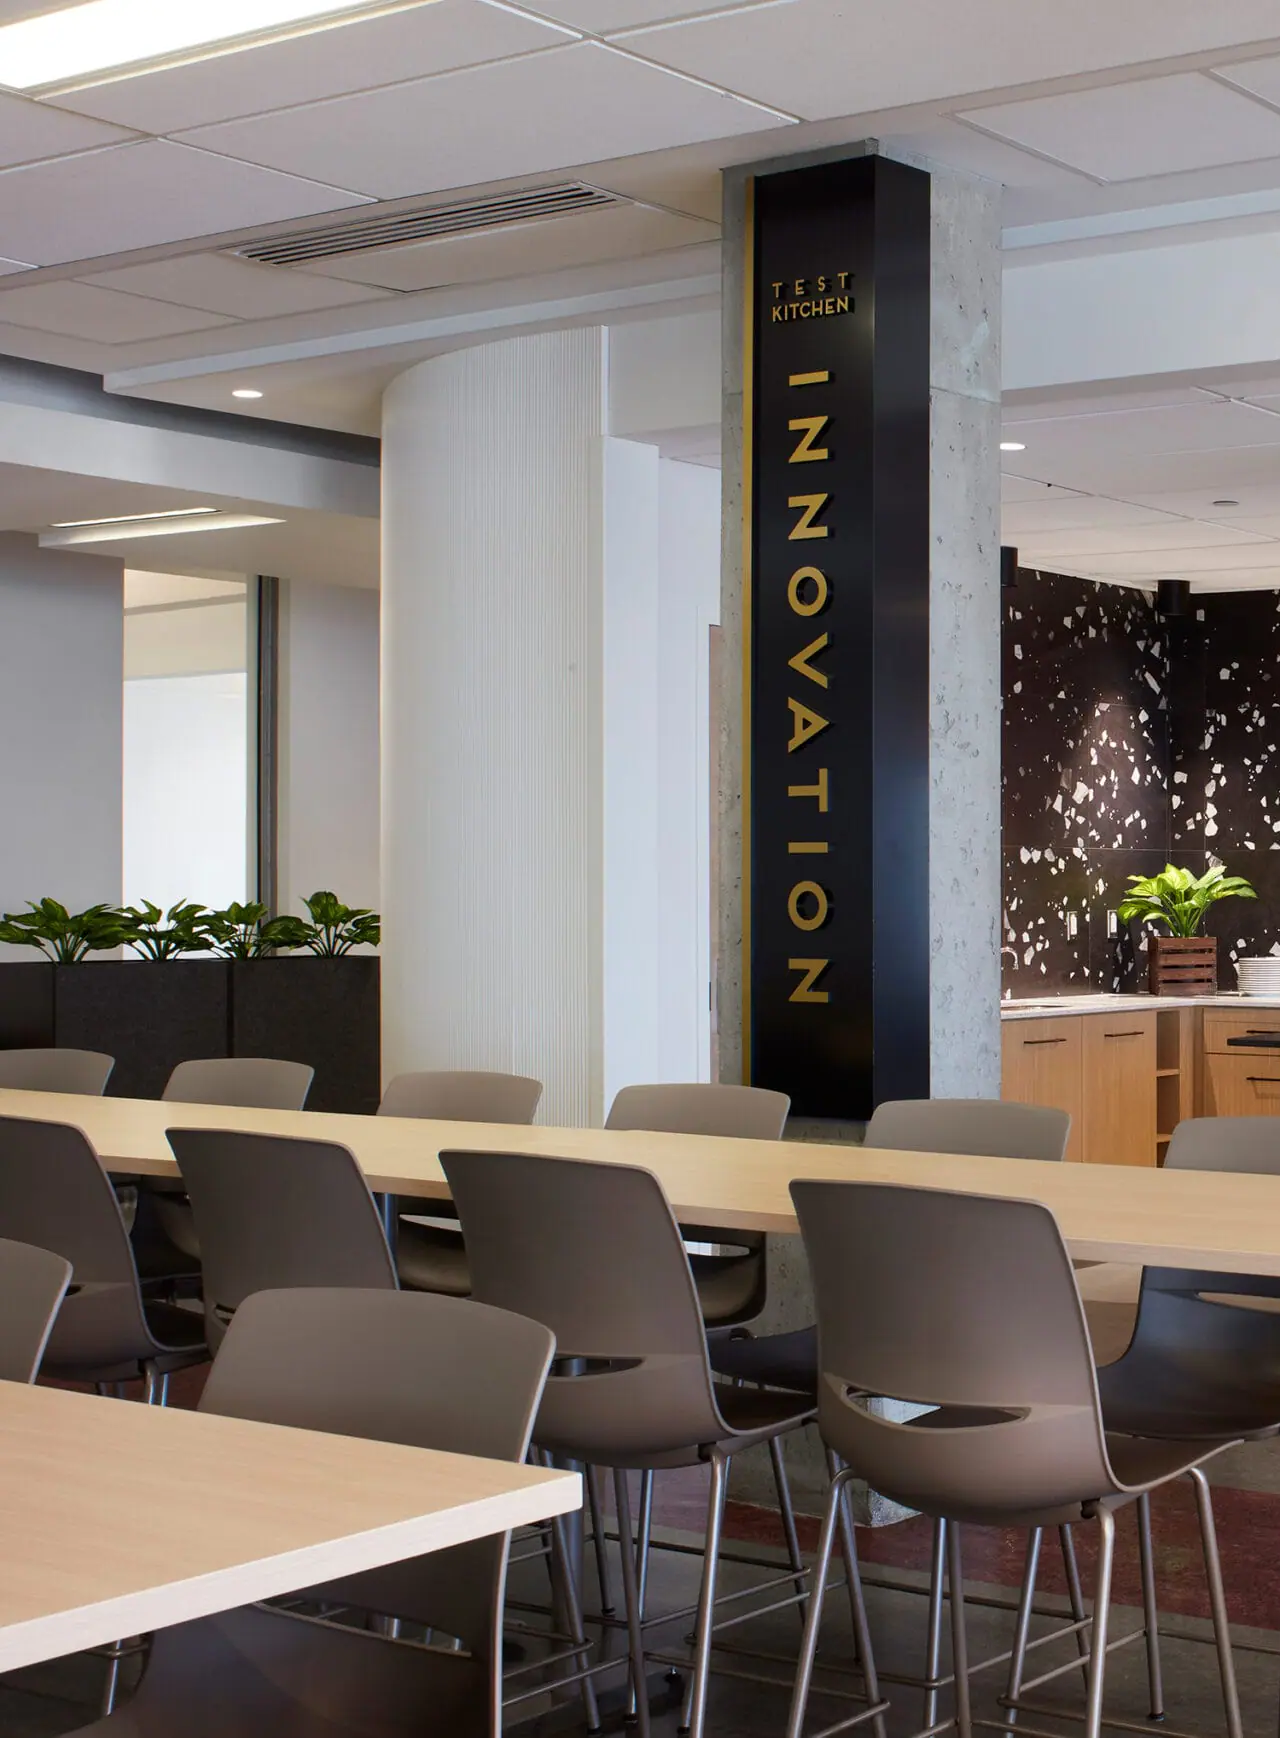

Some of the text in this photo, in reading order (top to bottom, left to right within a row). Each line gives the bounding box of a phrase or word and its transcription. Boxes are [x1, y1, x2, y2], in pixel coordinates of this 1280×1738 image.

[772, 272, 848, 298] TEST
[772, 296, 849, 322] KITCHEN
[788, 370, 830, 1003] INNOVATION
